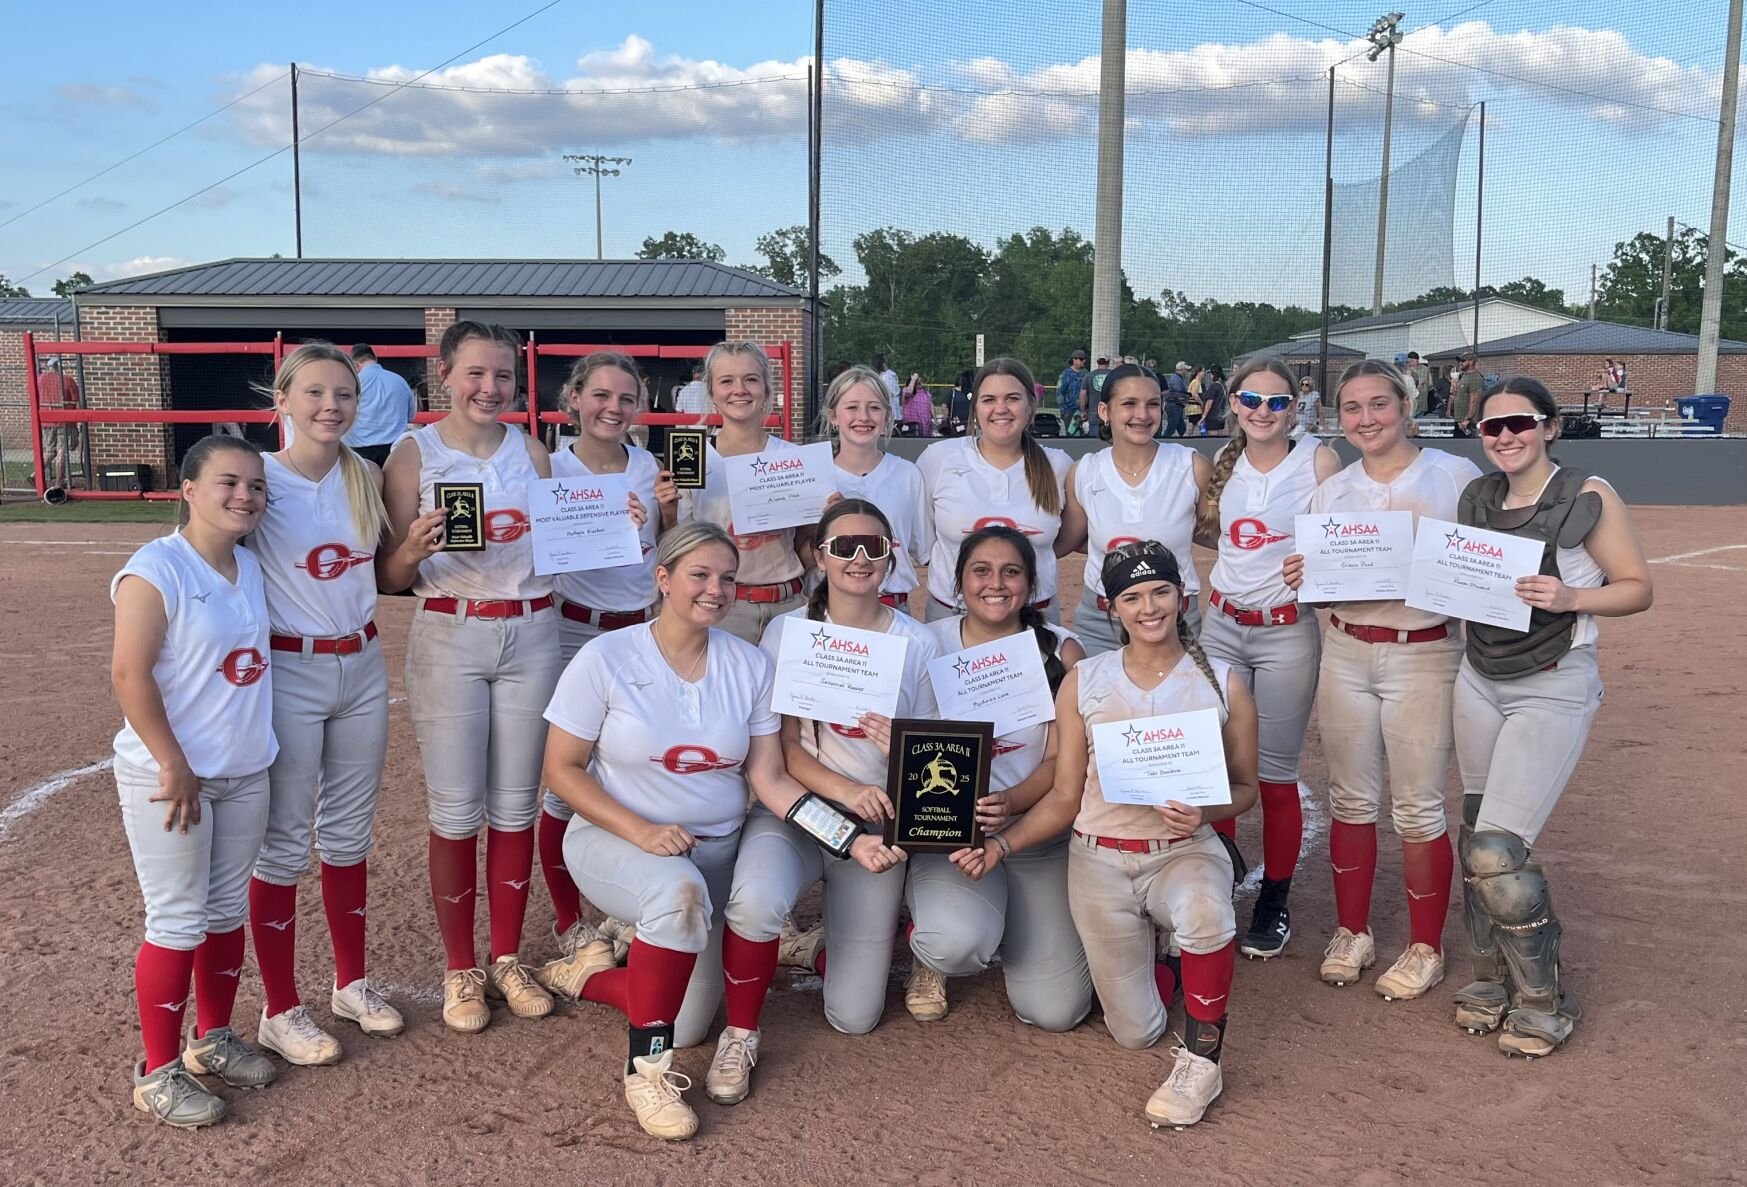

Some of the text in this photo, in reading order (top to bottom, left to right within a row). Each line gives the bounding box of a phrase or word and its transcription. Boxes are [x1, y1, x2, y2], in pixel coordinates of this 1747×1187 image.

[768, 459, 803, 472] AHSAA
[766, 481, 794, 489] VALUABLE
[795, 477, 816, 485] PLAYER
[570, 488, 604, 500] AHSAA
[1341, 524, 1379, 535] AHSAA
[1463, 541, 1503, 558] AHSAA
[1449, 553, 1468, 562] CLASS
[1478, 560, 1494, 568] AREA
[1130, 569, 1156, 579] adidas
[1437, 559, 1449, 567] ALL
[1450, 562, 1493, 576] TOURNAMENT
[1494, 572, 1512, 581] TEAM
[829, 639, 869, 656] AHSAA
[815, 652, 835, 661] CLASS
[844, 658, 862, 666] AREA
[971, 652, 1007, 672] AHSAA
[803, 659, 879, 678] ALL TOURNAMENT TEAM
[964, 675, 981, 686] CLASS
[989, 668, 1004, 678] AREA
[958, 688, 968, 697] ALL
[968, 676, 1006, 693] TOURNAMENT
[1006, 672, 1023, 681] TEAM
[1144, 728, 1184, 742] AHSAA
[912, 742, 933, 755] CLASS
[946, 743, 964, 755] AREA
[1132, 746, 1152, 755] CLASS
[1135, 752, 1181, 763] TOURNAMENT
[1181, 750, 1200, 758] TEAM
[908, 773, 918, 781] 20
[960, 774, 970, 783] 25
[921, 806, 951, 814] SOFTBALL
[913, 814, 958, 822] TOURNAMENT
[908, 826, 962, 839] Champion
